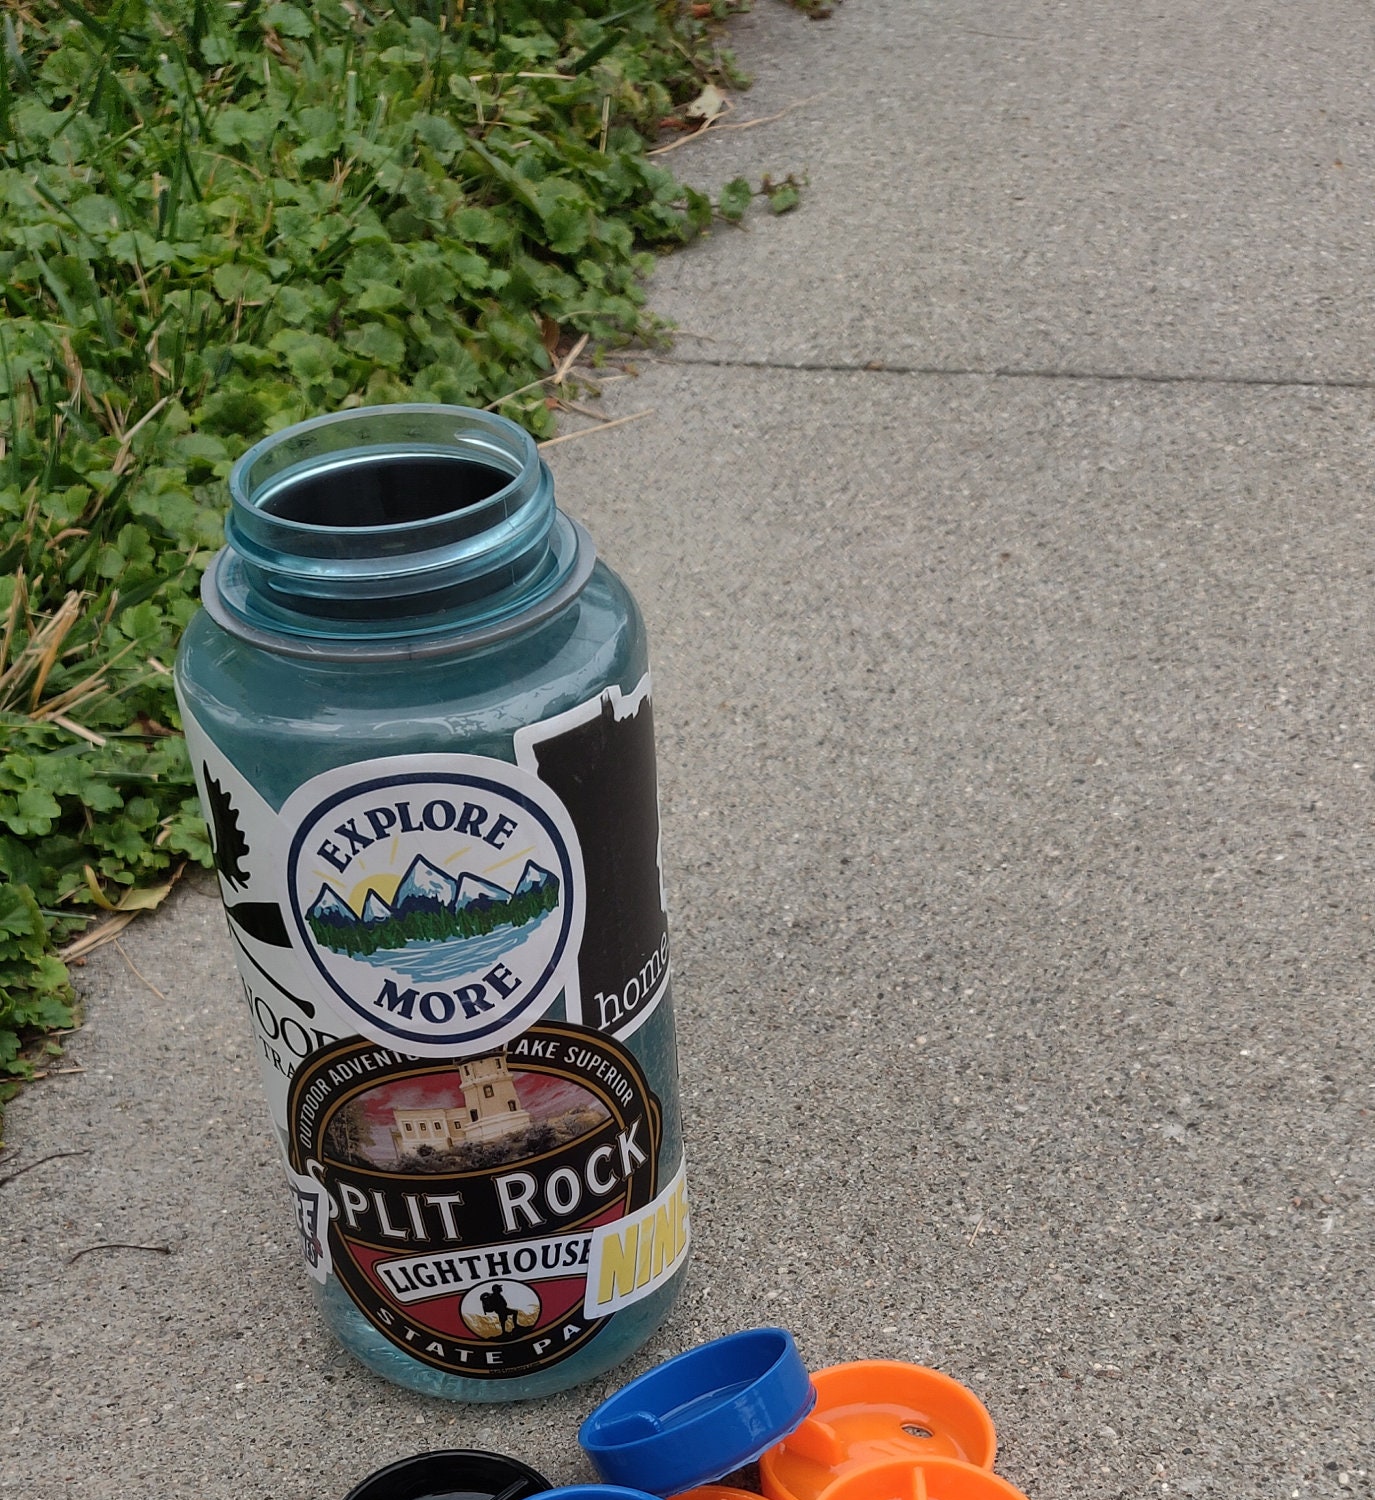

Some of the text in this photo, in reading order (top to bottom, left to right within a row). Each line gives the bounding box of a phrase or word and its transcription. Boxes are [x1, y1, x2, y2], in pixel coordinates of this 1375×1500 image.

[317, 800, 518, 873] EXPLORE
[373, 962, 523, 1023] MORE
[594, 931, 668, 1031] home
[563, 1046, 634, 1108] SUPERIOR
[300, 1077, 332, 1149] OUTDOOR
[305, 1114, 647, 1243] SPLIT ROCK
[383, 1239, 592, 1295] LIGHTHOUSE
[377, 1307, 504, 1366] STATE
